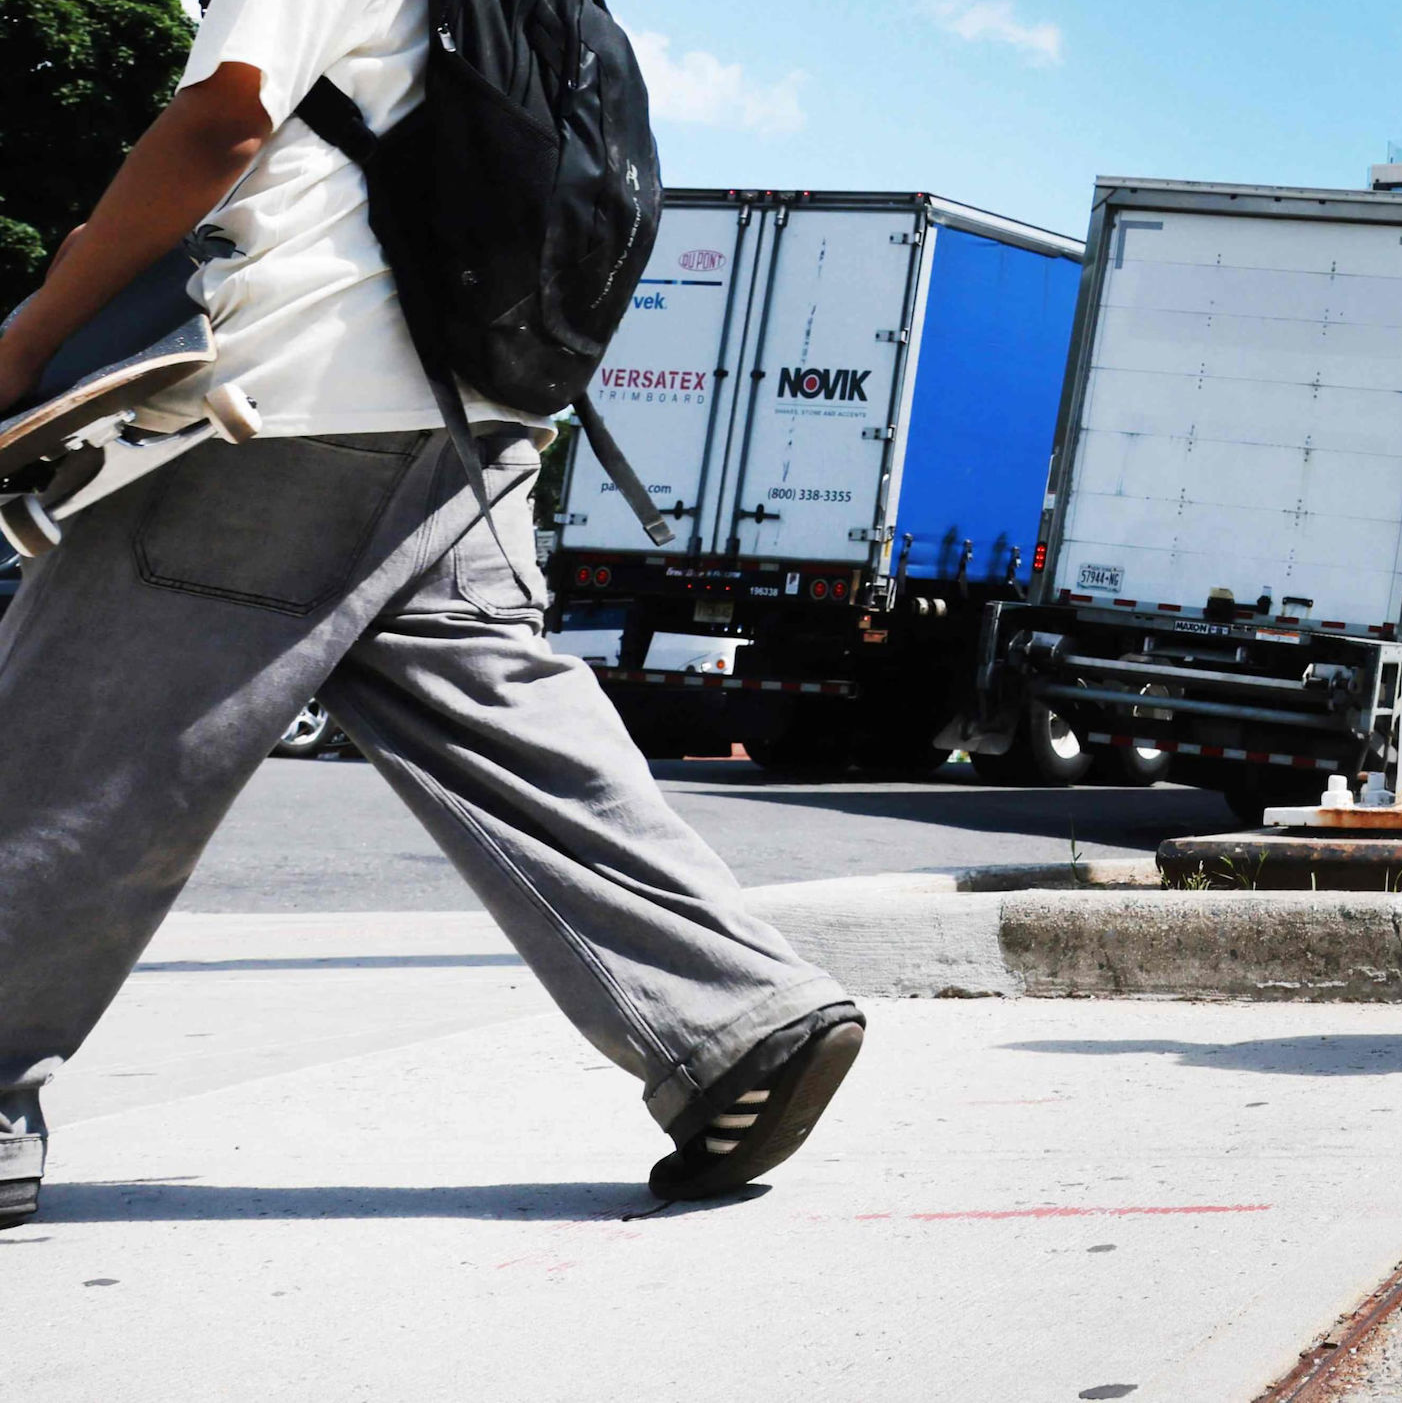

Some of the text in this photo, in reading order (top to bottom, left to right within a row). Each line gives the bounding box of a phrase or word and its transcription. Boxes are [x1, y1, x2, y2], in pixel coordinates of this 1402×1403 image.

[602, 368, 706, 391] VERSATEX
[777, 367, 872, 401] NOVIK
[599, 390, 704, 404] TRIMBOARD
[768, 487, 852, 502] (800) 338-3355
[1176, 621, 1208, 633] MAXON
